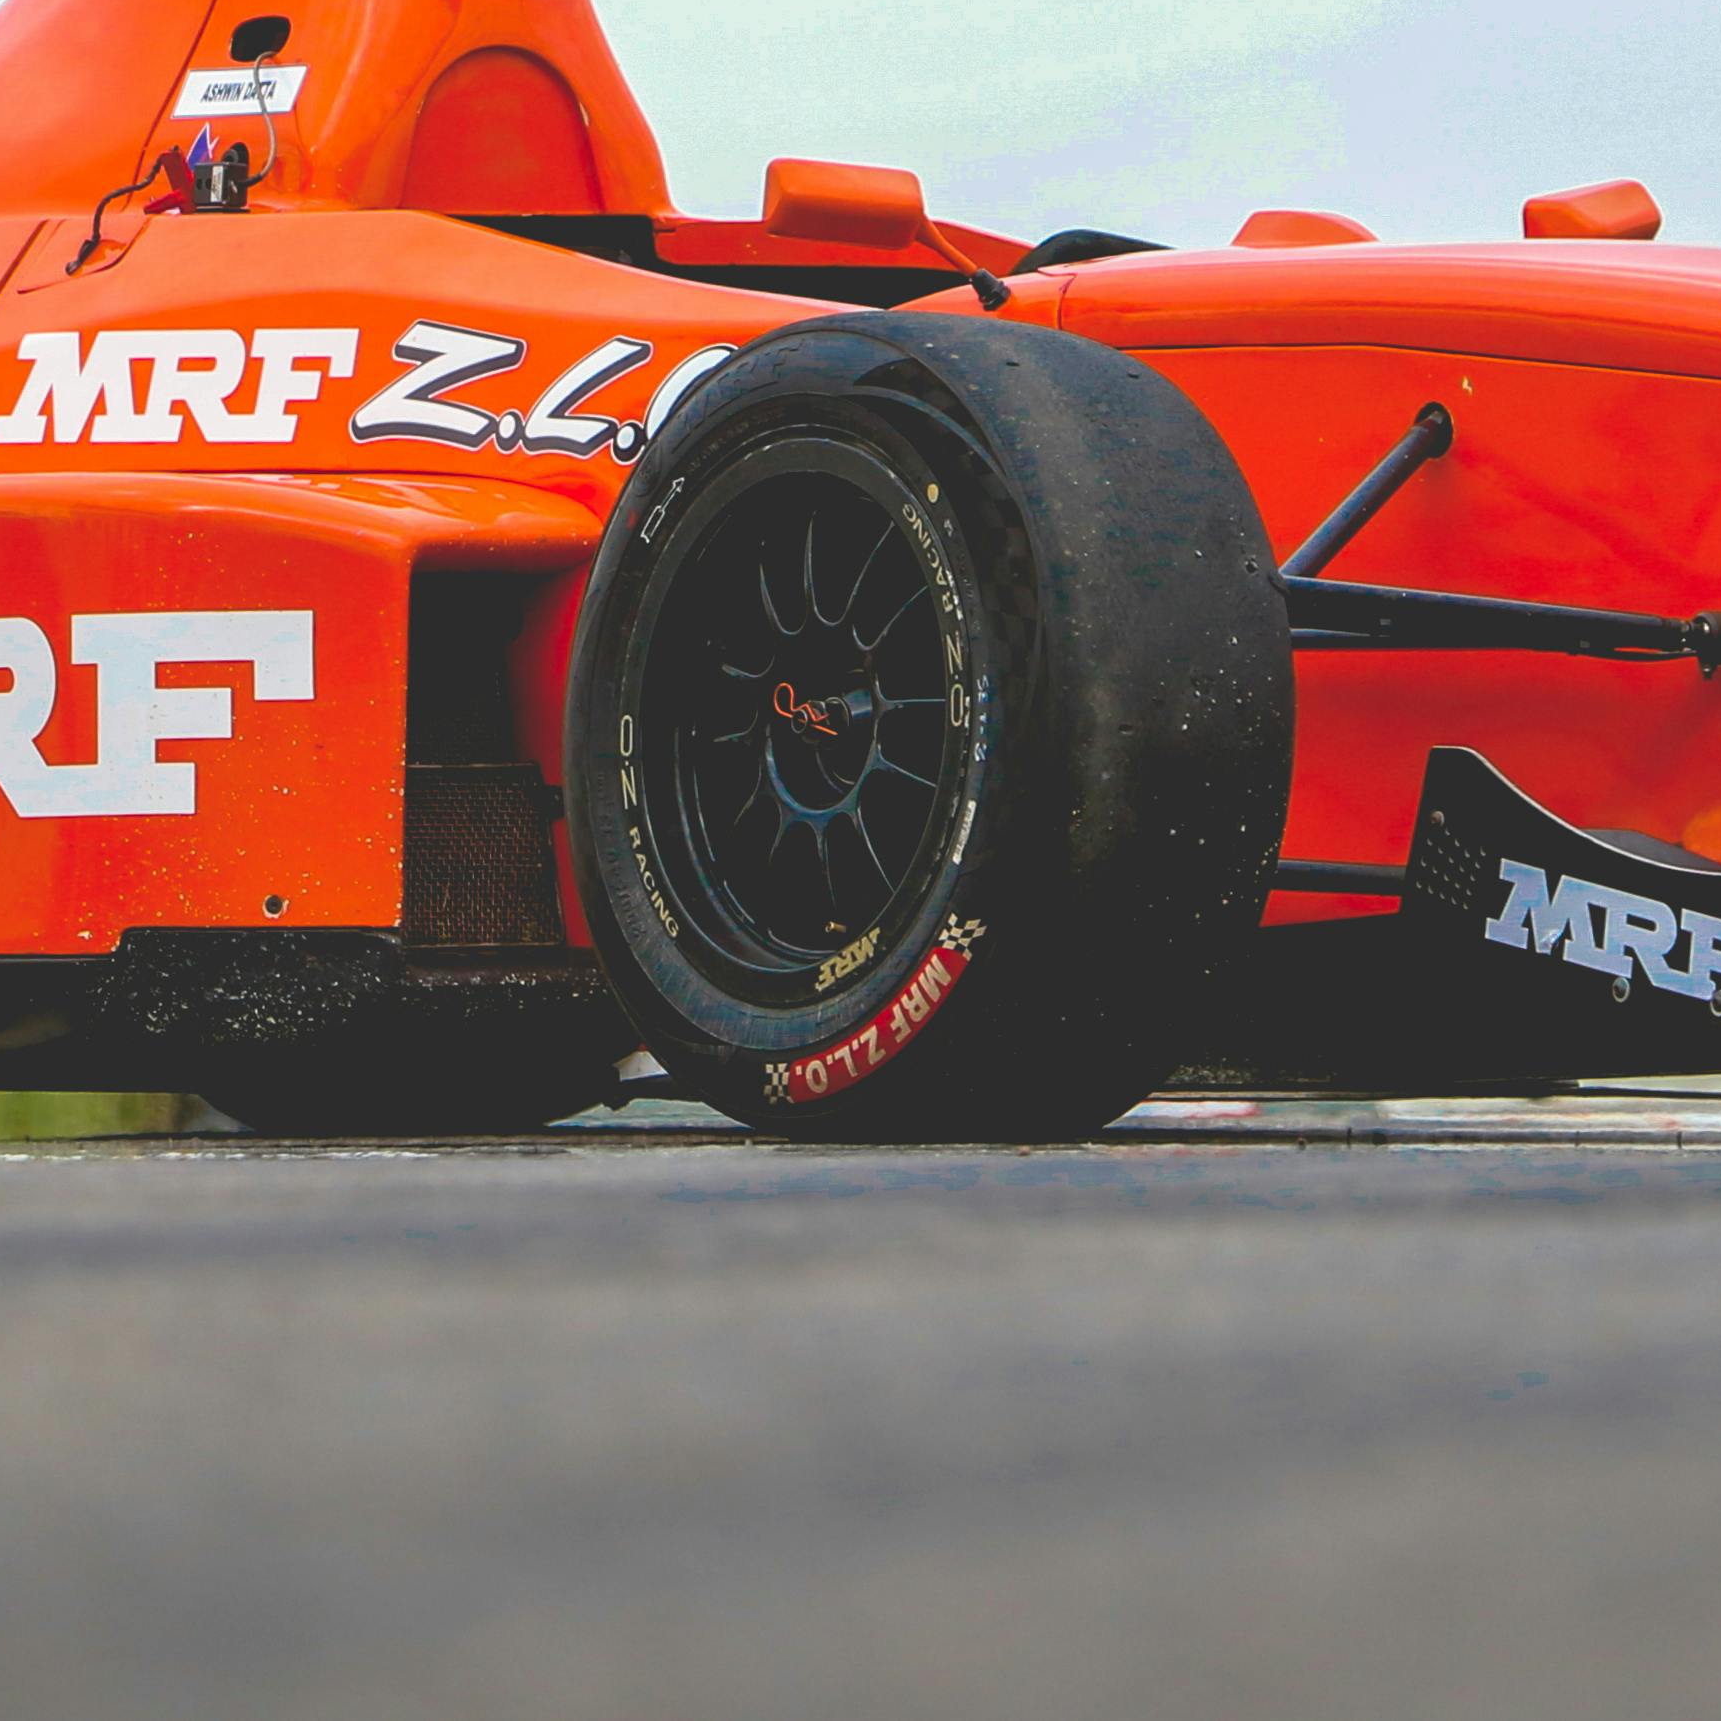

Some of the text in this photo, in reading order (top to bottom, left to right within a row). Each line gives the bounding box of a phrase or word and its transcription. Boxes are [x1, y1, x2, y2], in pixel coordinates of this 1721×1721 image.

[200, 81, 245, 103] ASHWIN
[902, 503, 954, 613] RACING
[629, 825, 680, 938] RACING
[814, 926, 881, 992] MRF
[795, 953, 952, 1094] MRF Z.L.O.
